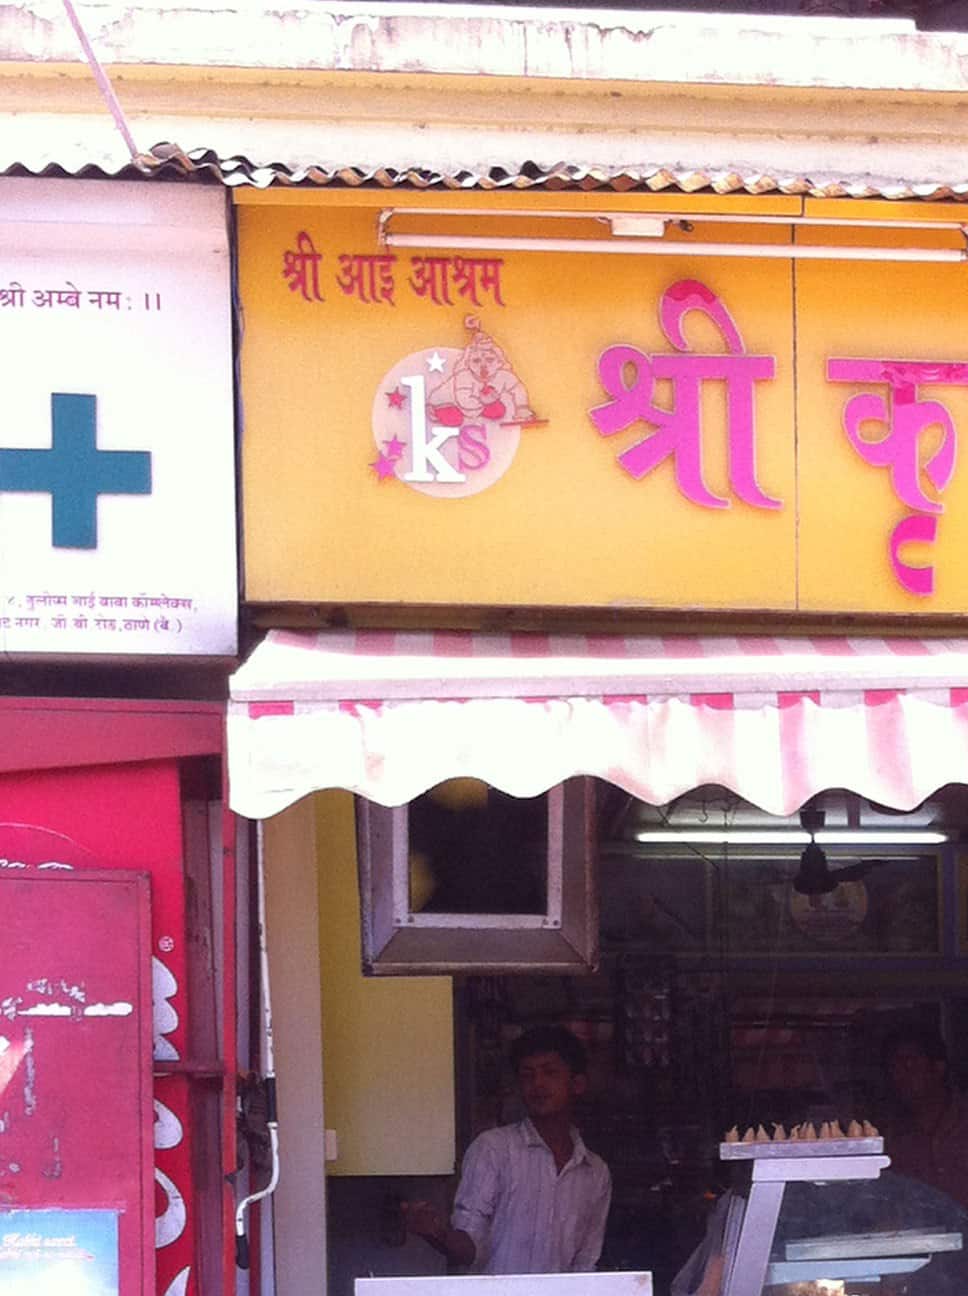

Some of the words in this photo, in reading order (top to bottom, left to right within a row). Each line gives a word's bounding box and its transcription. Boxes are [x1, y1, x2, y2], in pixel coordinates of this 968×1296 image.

[281, 231, 325, 302] श्री
[408, 255, 506, 307] आश्रम
[589, 278, 784, 512] श्री
